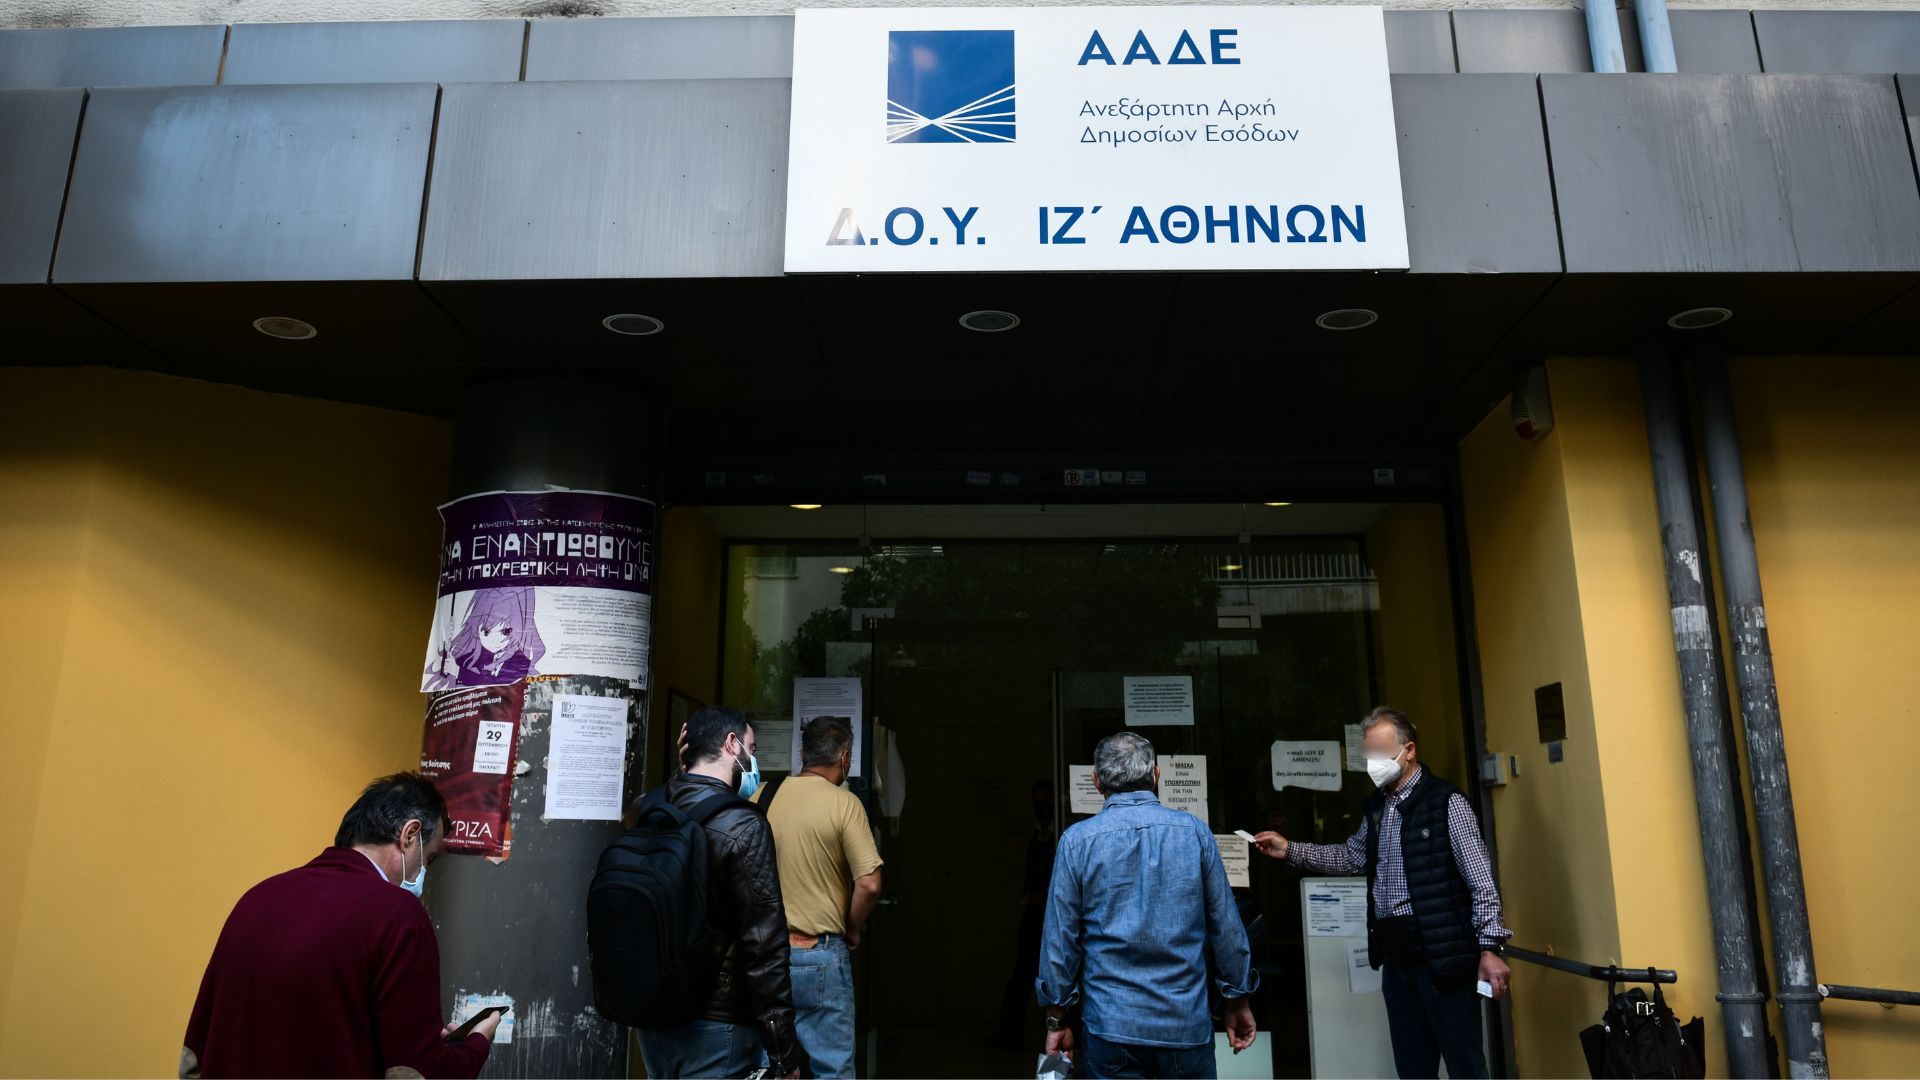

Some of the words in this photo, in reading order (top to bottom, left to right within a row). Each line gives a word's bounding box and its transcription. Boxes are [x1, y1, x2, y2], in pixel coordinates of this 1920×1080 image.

[1077, 28, 1241, 65] ΑΑΔΕ
[1079, 98, 1210, 120] Ανεξάρτητη
[1217, 98, 1276, 121] Αρχή
[1080, 124, 1198, 147] Δημοσίων
[1205, 122, 1299, 144] Εσόδων
[825, 206, 986, 246] Δ.Ο.Υ.
[1119, 204, 1366, 245] ΑΘΗΝΩΝ
[486, 730, 502, 741] 29
